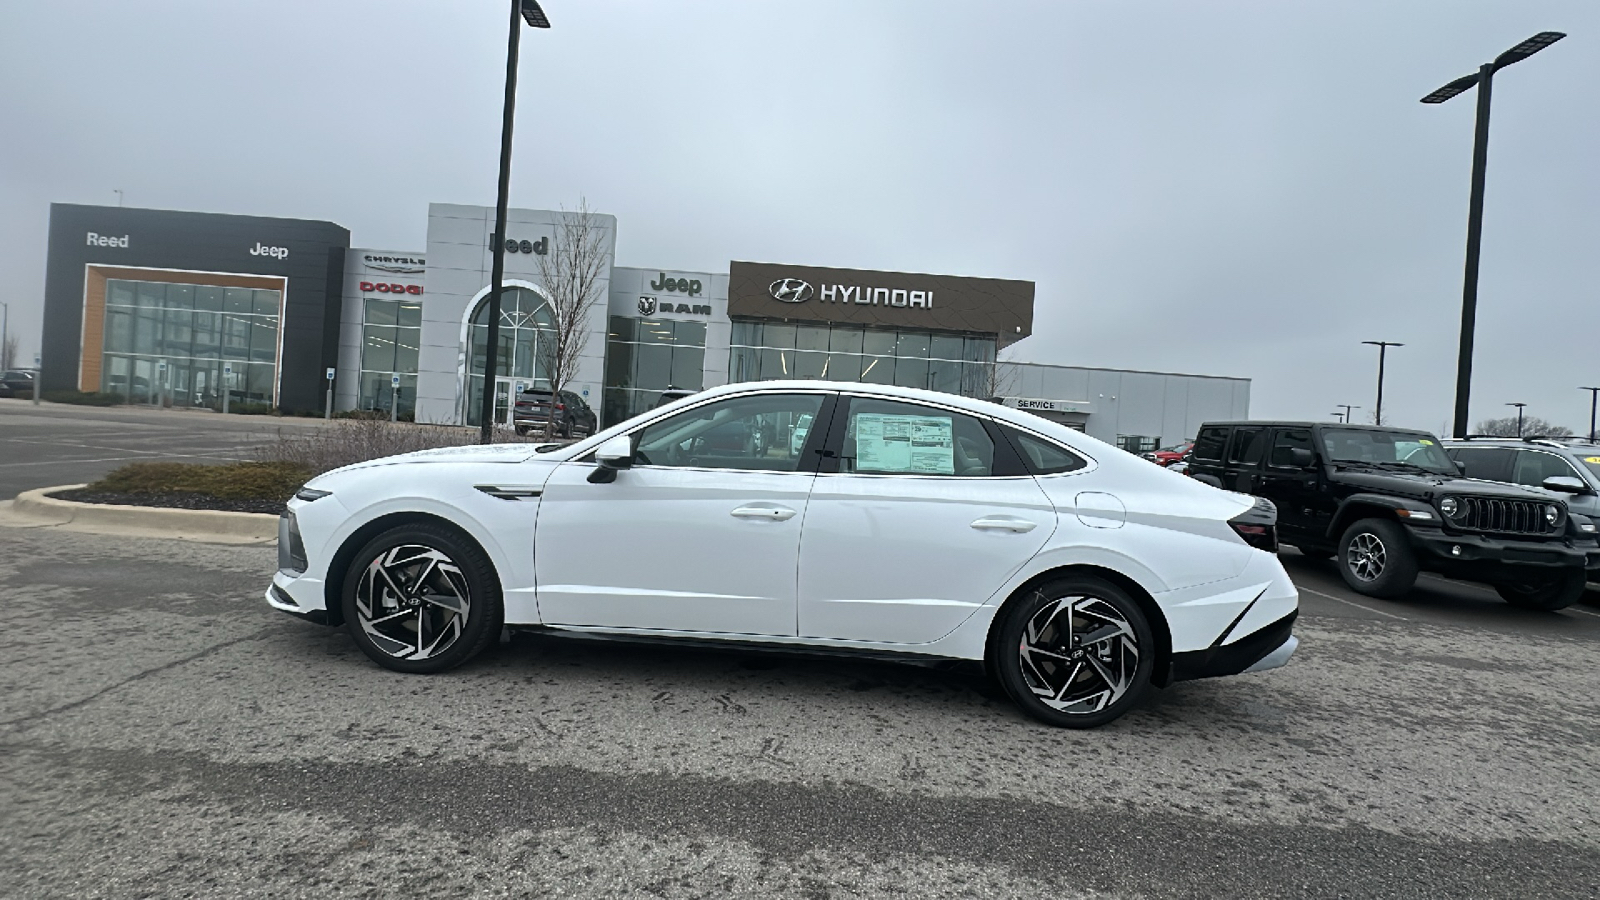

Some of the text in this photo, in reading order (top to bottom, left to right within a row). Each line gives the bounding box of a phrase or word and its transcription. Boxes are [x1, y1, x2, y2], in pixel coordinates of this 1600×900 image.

[86, 231, 129, 248] Reed
[249, 242, 289, 259] Jeep
[359, 281, 424, 296] DODG
[650, 272, 702, 296] Jeep
[819, 284, 934, 309] HYUNDAI
[659, 302, 712, 315] RAM
[1017, 399, 1055, 410] SERVICE
